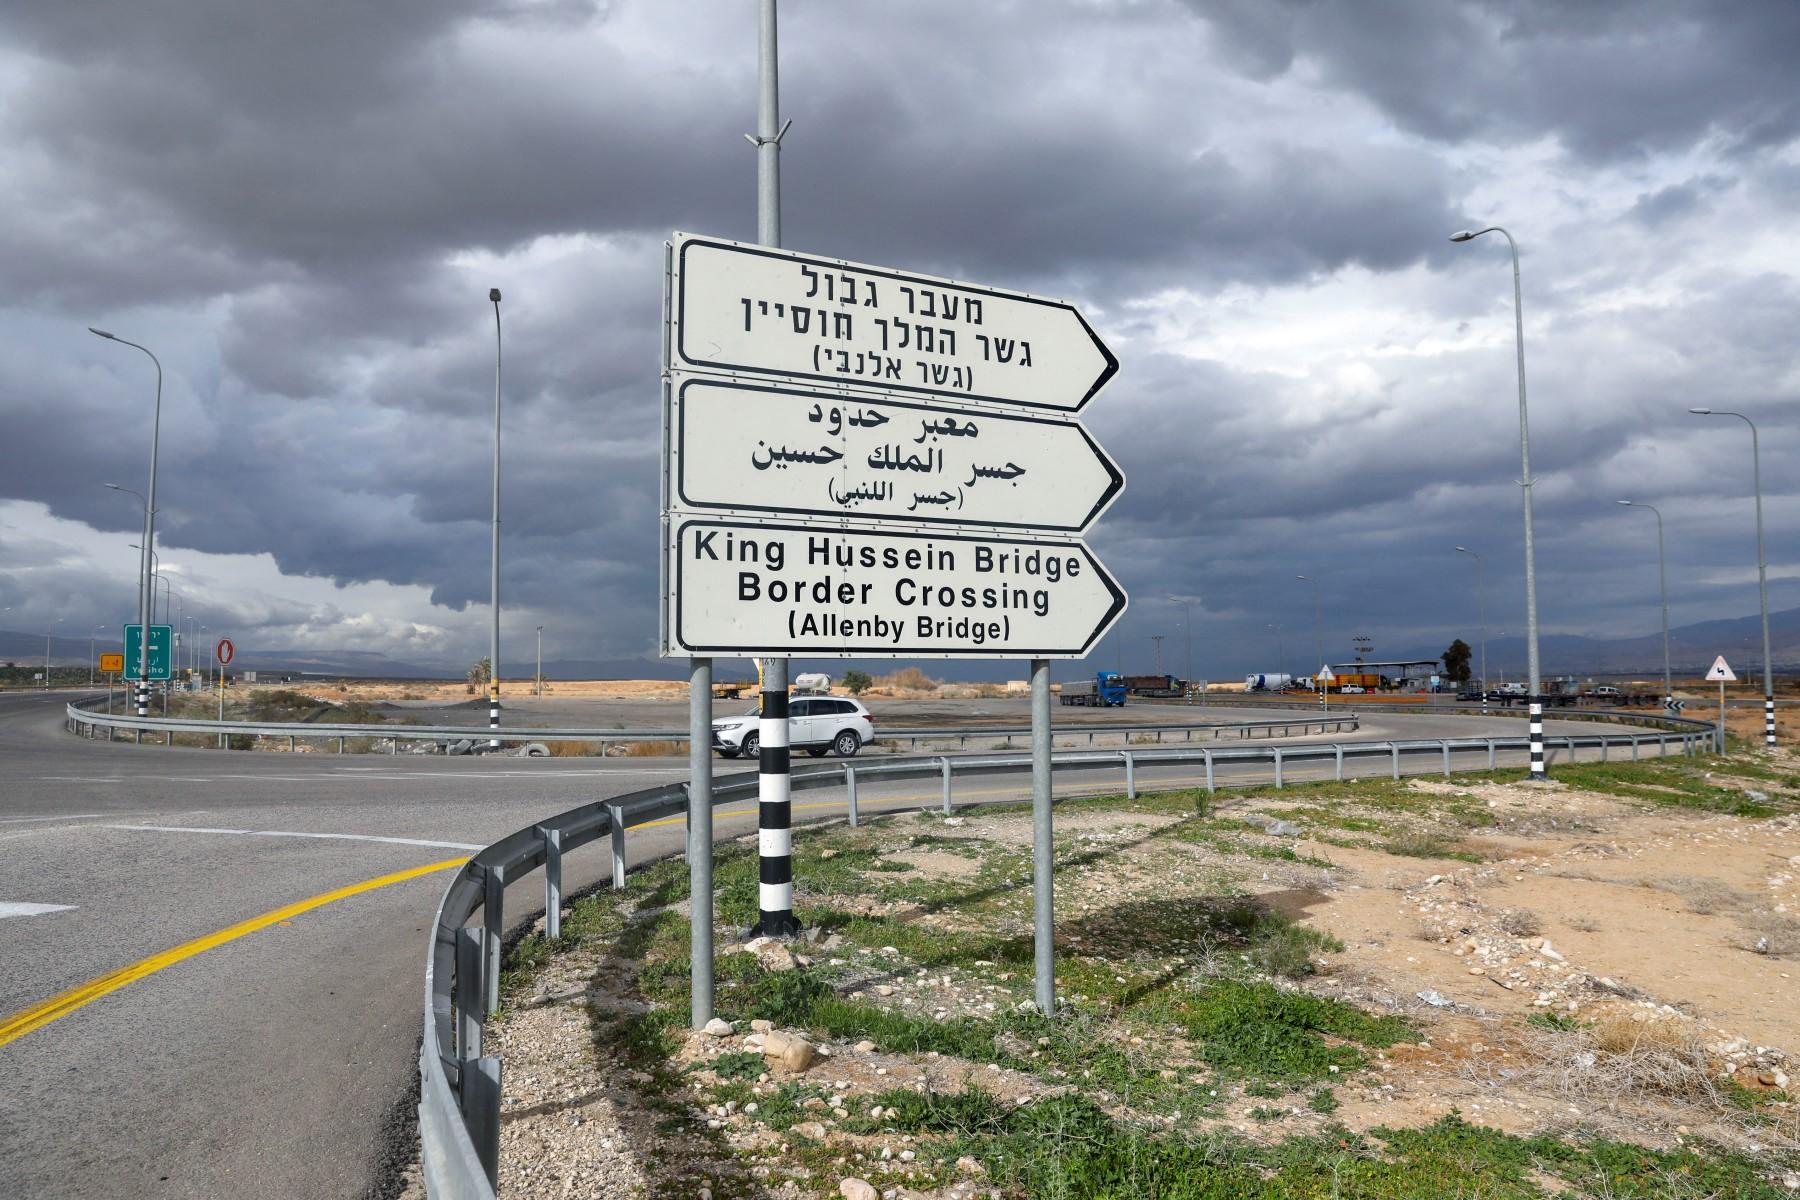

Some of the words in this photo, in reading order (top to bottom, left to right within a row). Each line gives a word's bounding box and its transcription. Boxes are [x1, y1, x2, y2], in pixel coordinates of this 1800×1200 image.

[801, 264, 878, 309] גבול
[741, 298, 853, 341] חוסיין
[899, 287, 983, 326] מעבר
[874, 316, 956, 356] המלך
[975, 335, 1032, 368] גשר
[813, 344, 902, 381] אלנבי)
[916, 362, 973, 393] (גשר
[808, 403, 890, 436] حدود
[913, 418, 979, 443] معبر
[751, 440, 845, 471] حسين
[867, 444, 944, 474] الملك
[963, 462, 1027, 488] جسر
[828, 478, 894, 509] اللنبي)
[907, 487, 964, 512] (جسر
[695, 531, 785, 572] King
[808, 536, 956, 575] Hussein
[975, 545, 1081, 583] Bridge
[738, 572, 873, 605] Border
[895, 578, 1049, 617] Crossing
[788, 610, 905, 644] (Allenby
[917, 615, 1010, 645] Bridge)
